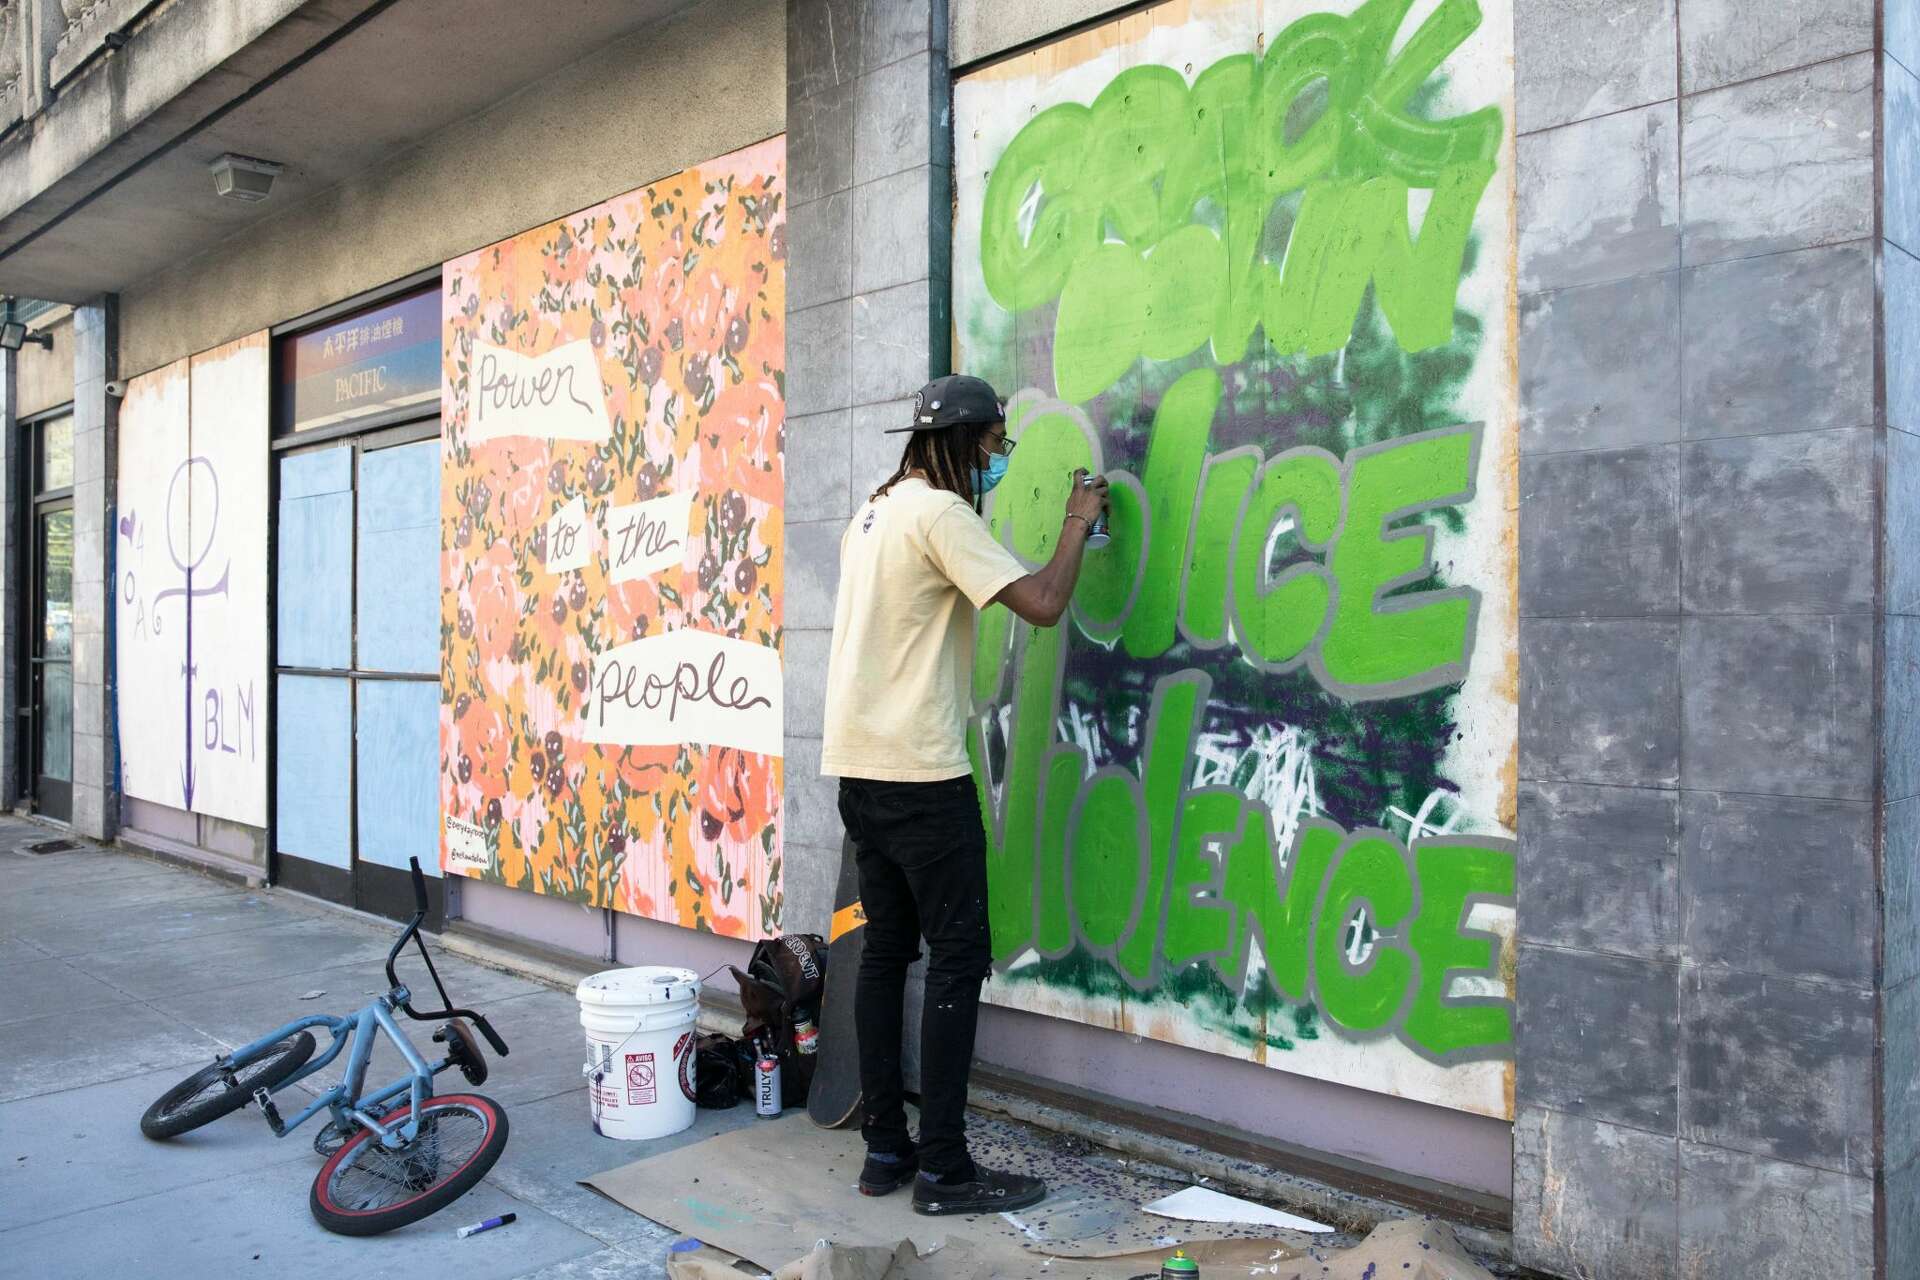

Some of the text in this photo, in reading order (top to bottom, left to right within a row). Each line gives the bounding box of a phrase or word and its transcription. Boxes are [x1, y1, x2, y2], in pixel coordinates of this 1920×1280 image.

[335, 366, 387, 402] PACIFIC
[478, 353, 594, 422] Power
[550, 512, 680, 569] to the
[204, 679, 255, 763] BLM
[596, 651, 772, 728] people
[761, 1072, 772, 1108] TRULY
